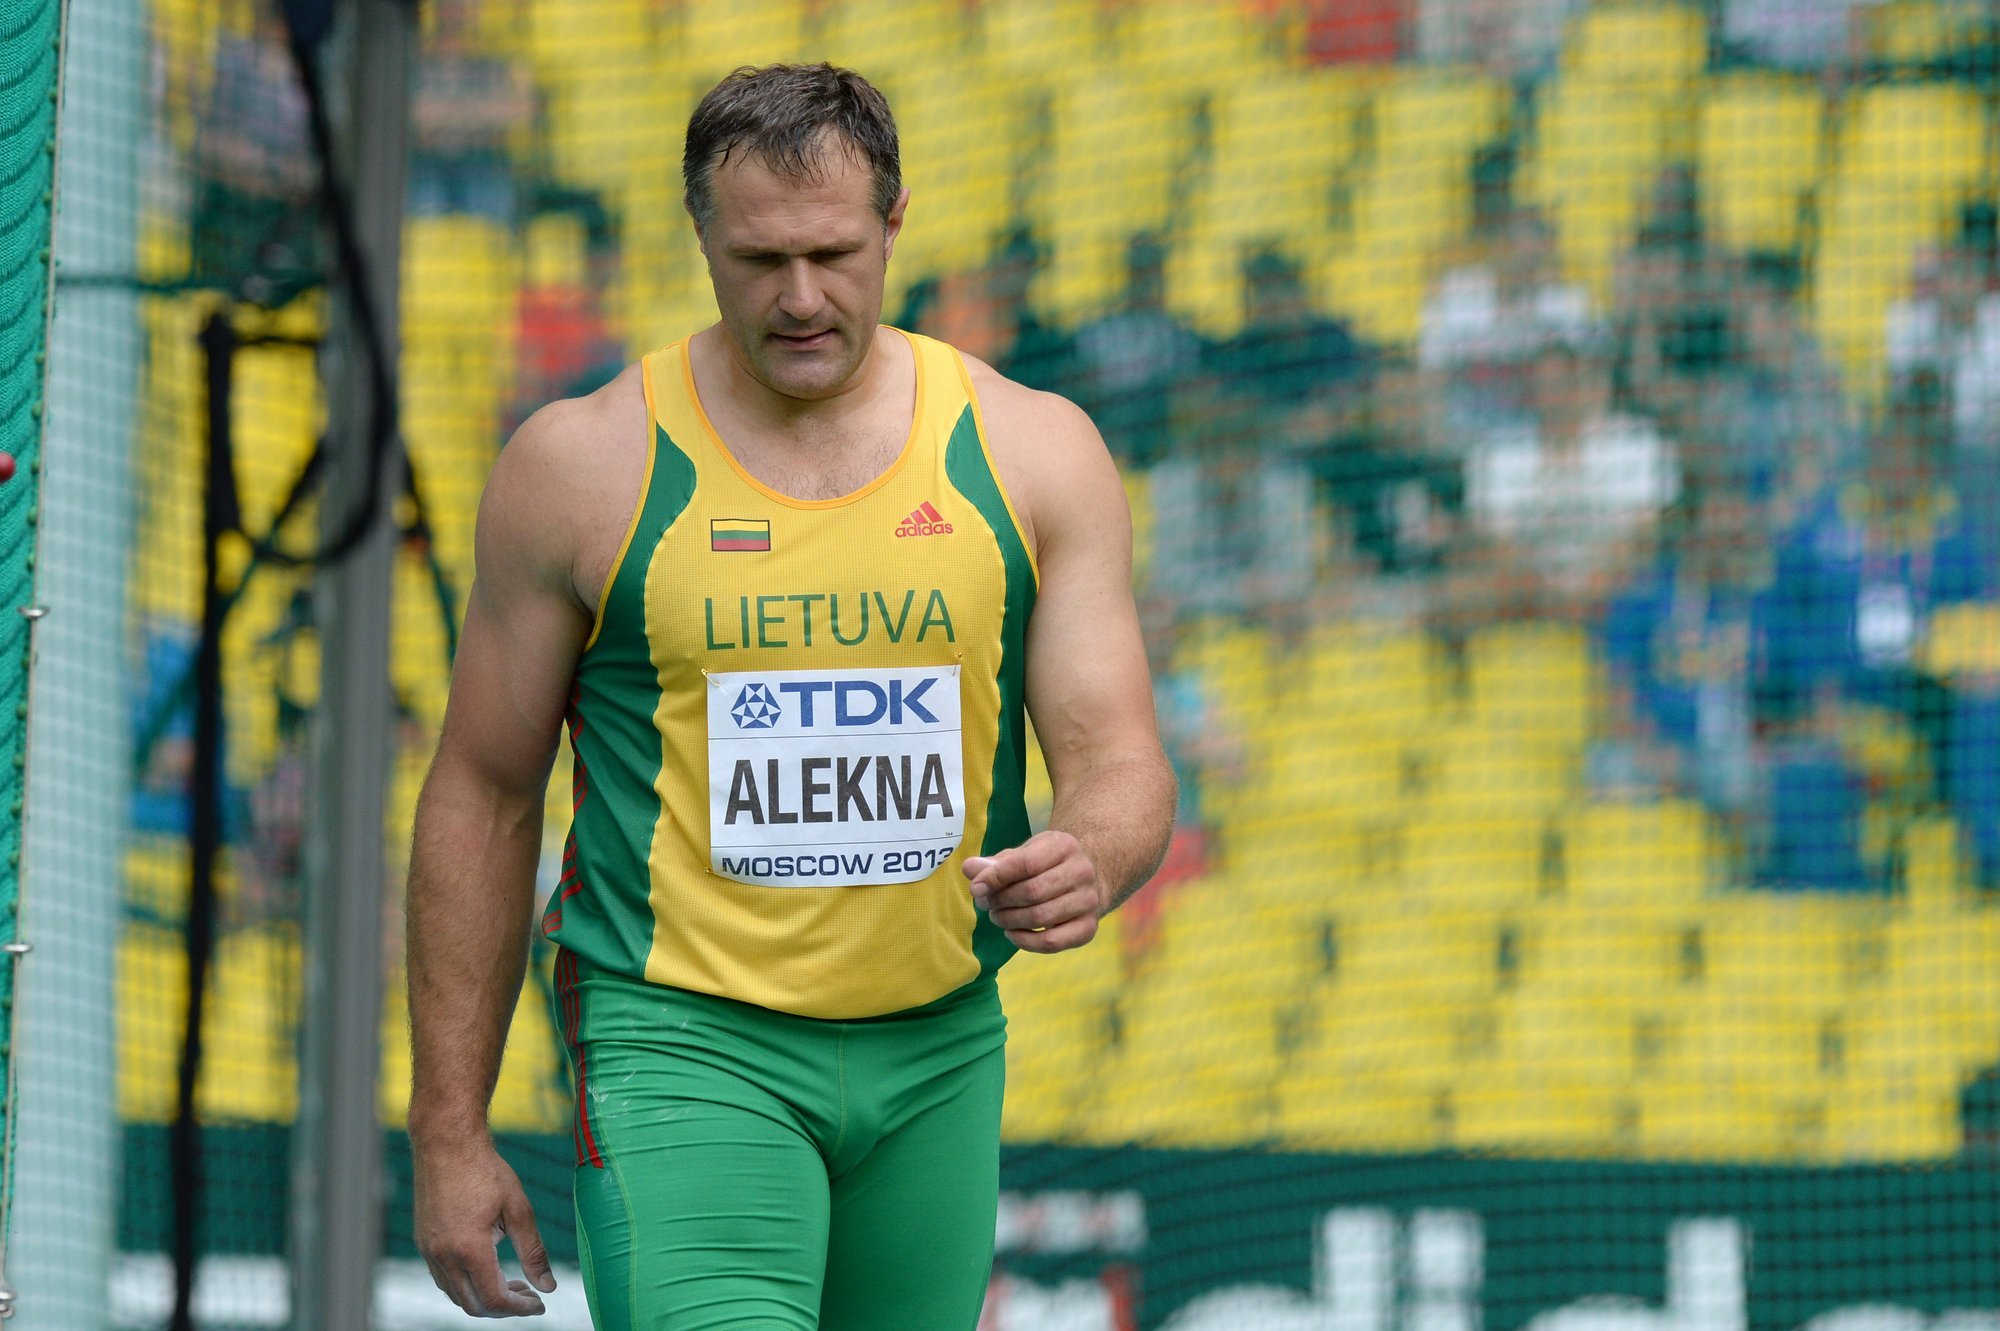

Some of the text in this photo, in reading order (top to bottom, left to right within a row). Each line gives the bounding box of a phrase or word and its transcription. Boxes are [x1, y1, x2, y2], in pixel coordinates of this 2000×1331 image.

[895, 523, 954, 537] adidas
[704, 589, 956, 650] LIETUVA
[780, 678, 940, 727] TDK
[724, 753, 954, 825] ALEKNA
[722, 853, 873, 877] MOSCOW
